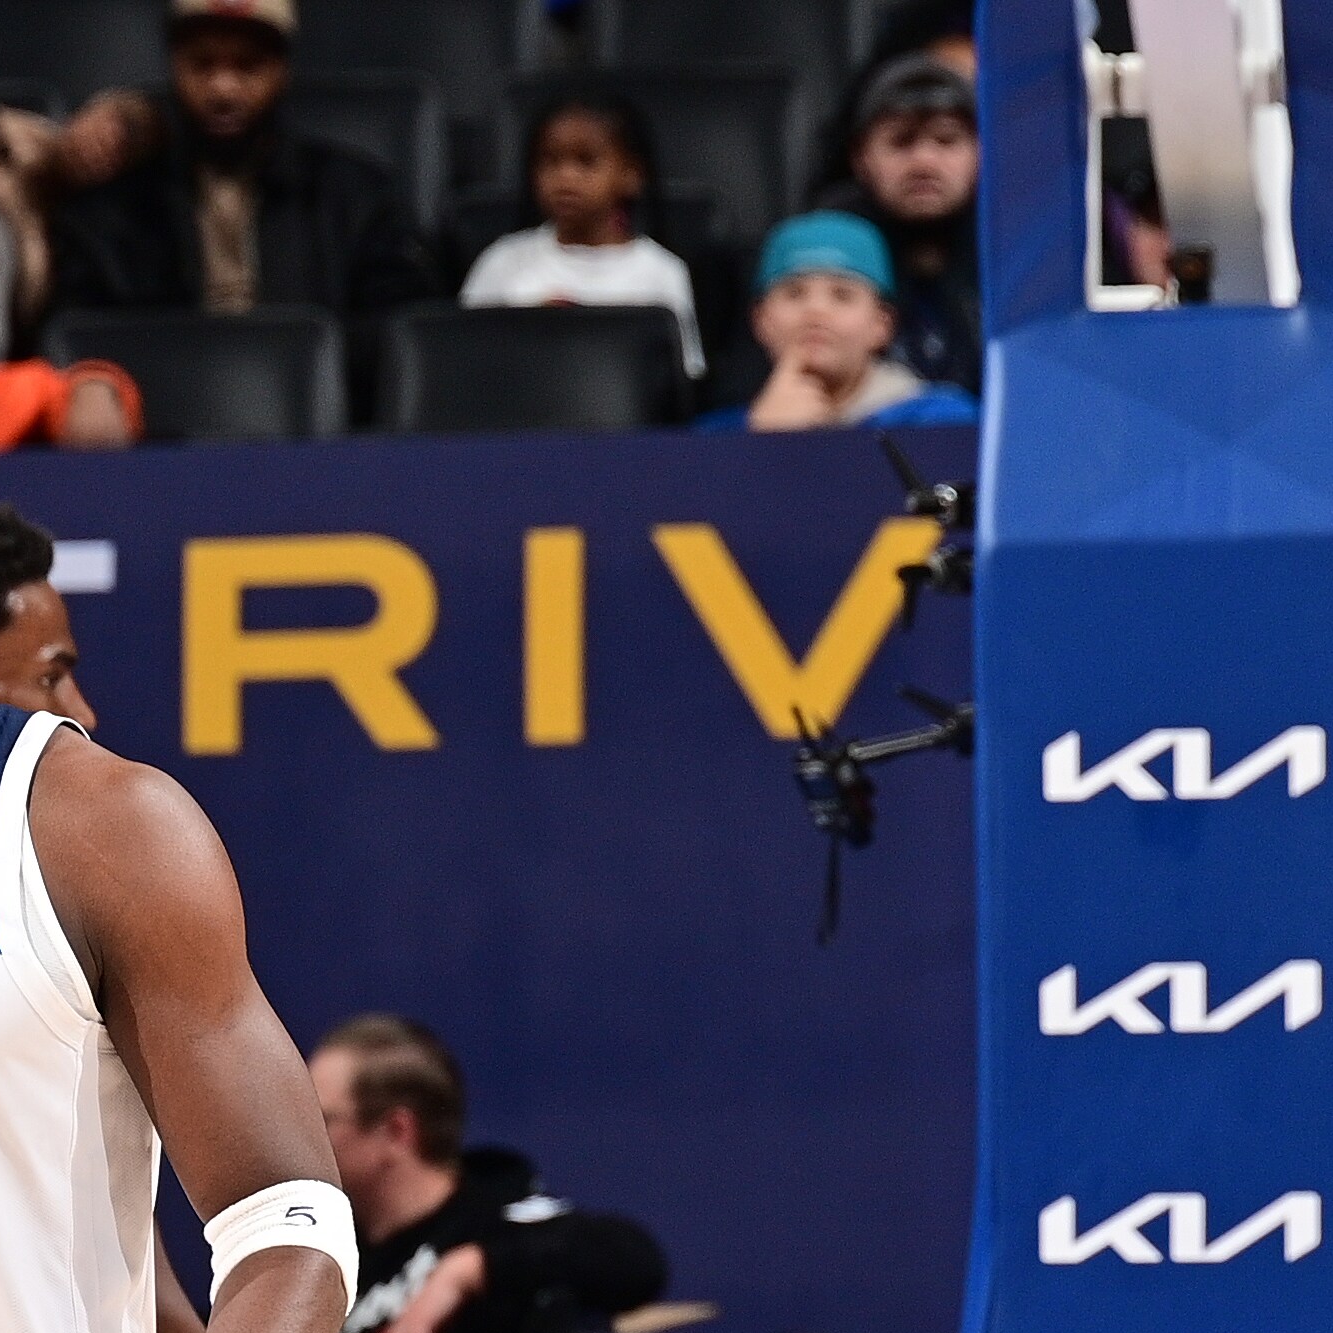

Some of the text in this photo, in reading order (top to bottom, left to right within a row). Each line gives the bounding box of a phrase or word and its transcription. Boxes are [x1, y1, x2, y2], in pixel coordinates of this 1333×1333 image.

[1041, 724, 1327, 803] KIA
[1038, 959, 1324, 1037] KIA
[285, 1206, 317, 1226] 5
[1038, 1190, 1323, 1266] KIA
